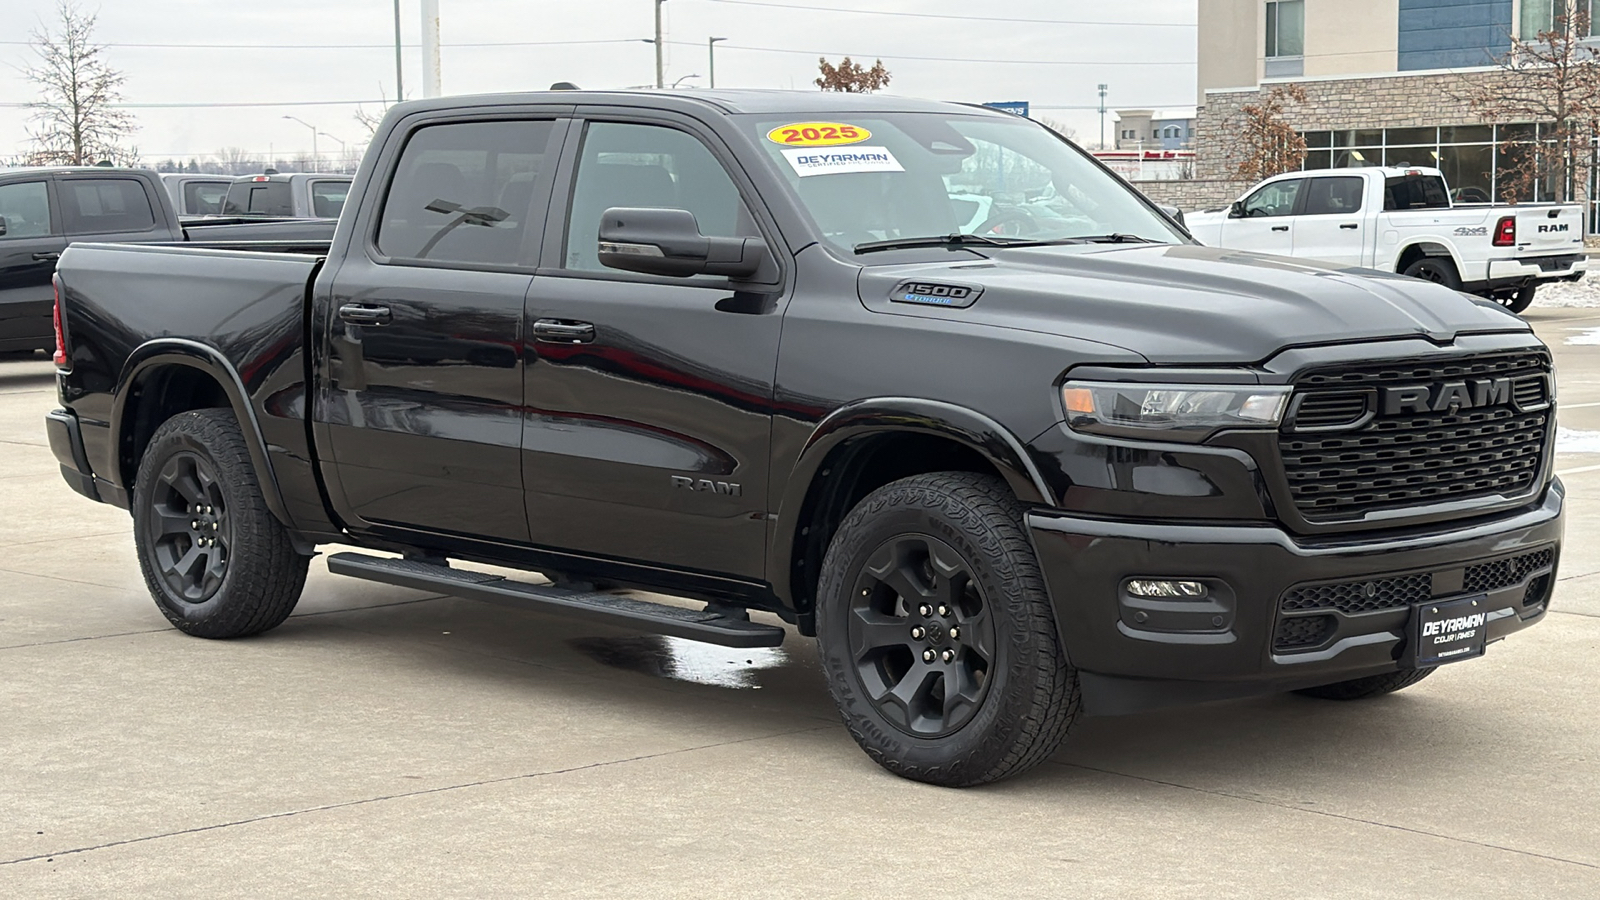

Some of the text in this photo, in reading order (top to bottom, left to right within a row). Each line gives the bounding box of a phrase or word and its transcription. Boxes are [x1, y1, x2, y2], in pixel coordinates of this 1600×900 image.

[781, 126, 860, 143] 2025
[797, 153, 888, 164] DEYARMAN
[1538, 224, 1569, 233] RAM
[907, 283, 967, 298] 1500
[1384, 377, 1510, 415] RAM
[671, 475, 742, 496] RAM
[1422, 612, 1485, 637] DEYARMAN
